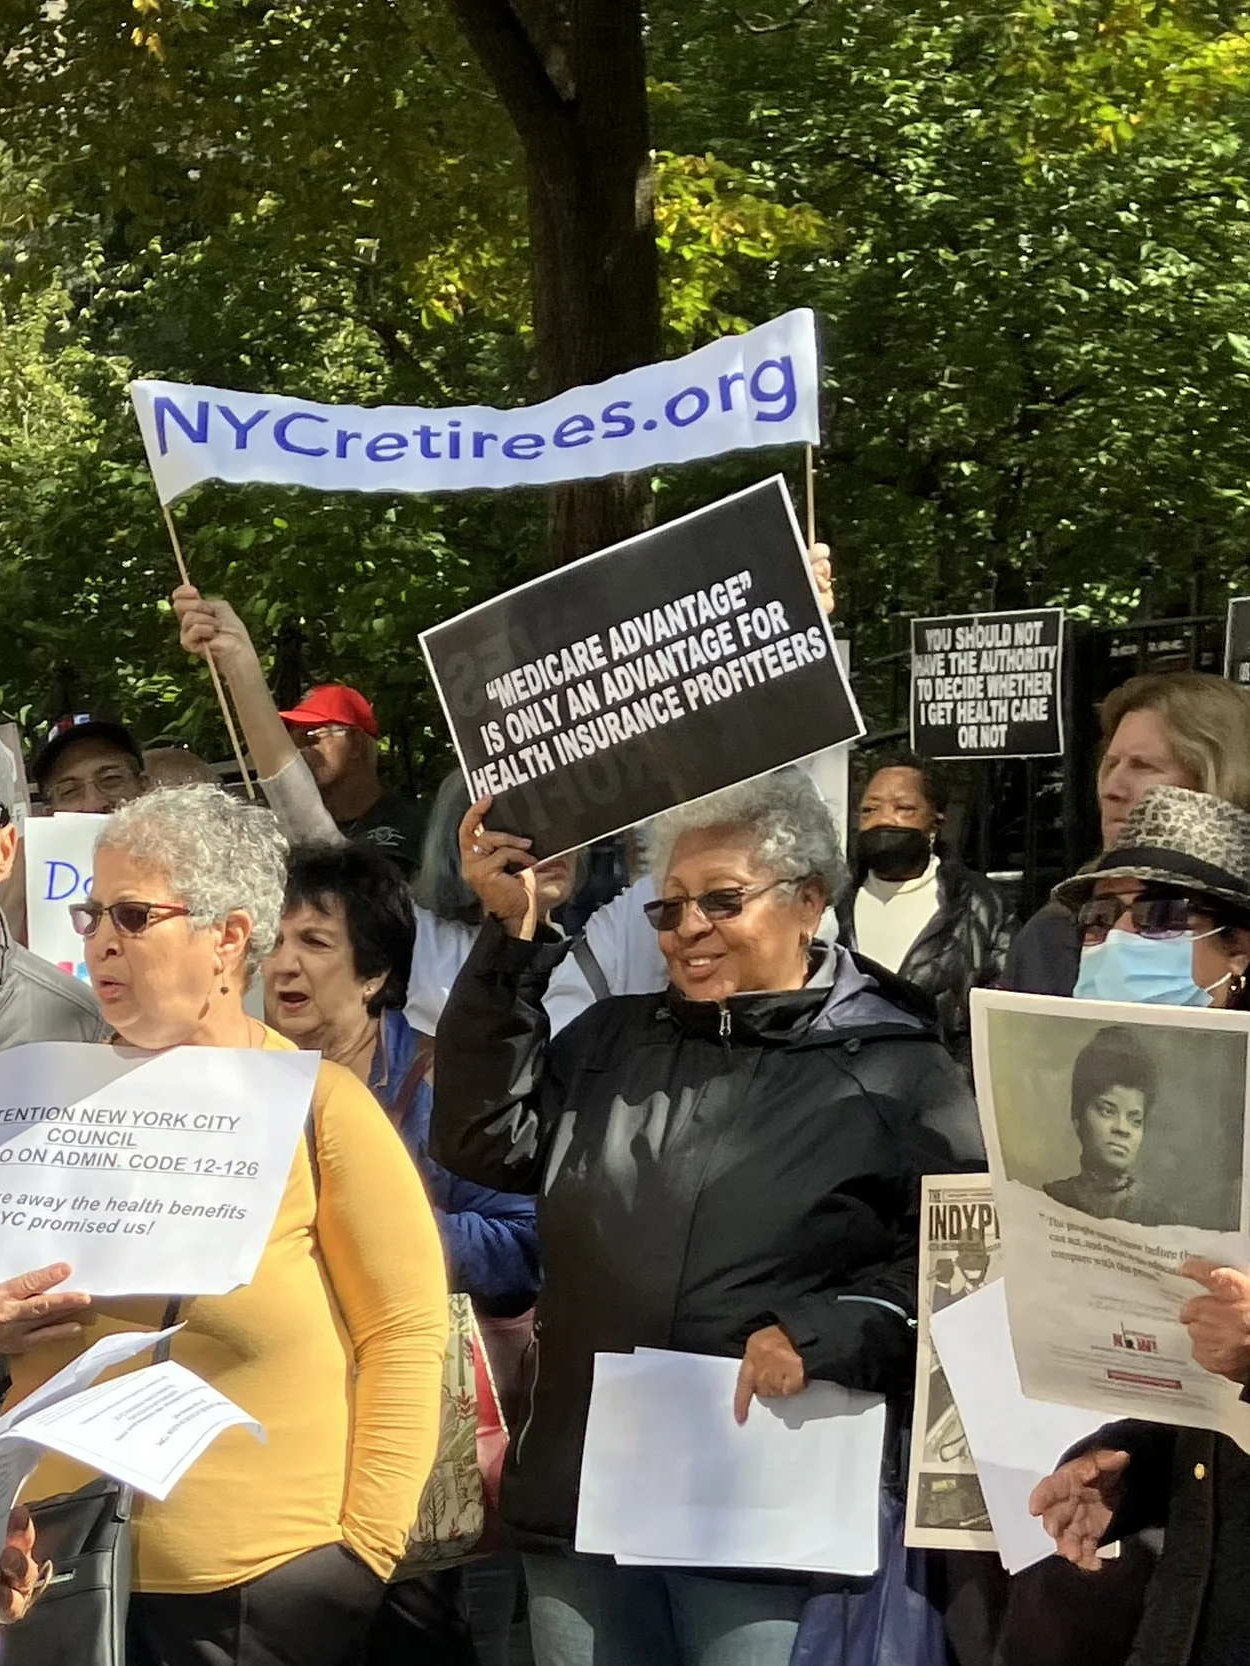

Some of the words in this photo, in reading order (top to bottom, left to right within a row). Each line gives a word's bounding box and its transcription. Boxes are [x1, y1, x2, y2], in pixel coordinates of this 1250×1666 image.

[153, 354, 798, 462] NYCretirees.org
[925, 627, 952, 651] YOU
[954, 622, 1012, 650] SHOULD
[1014, 620, 1044, 646] NOT
[914, 653, 946, 677] HAVE
[948, 651, 977, 675] THE
[979, 645, 1058, 673] AUTHORITY
[480, 720, 505, 756] IS
[506, 694, 562, 745] ONLY
[566, 679, 601, 720] AN
[602, 621, 738, 705] ADVANTAGE
[736, 600, 790, 648] FOR
[916, 678, 933, 701] TO
[934, 675, 985, 701] DECIDE
[986, 671, 1053, 698] WHETHER
[471, 741, 556, 800] HEALTH
[553, 685, 685, 766] INSURANCE
[682, 626, 827, 711] PROFITEERS
[920, 703, 926, 725] I
[927, 701, 954, 725] GET
[956, 699, 1008, 724] HEALTH
[1010, 697, 1049, 722] CARE
[958, 725, 978, 748] OR
[980, 724, 1008, 748] NOT
[80, 1109, 127, 1124] NEW
[132, 1110, 188, 1128] YORK
[193, 1114, 241, 1131] CITY
[47, 1128, 137, 1147] COUNCIL
[18, 1148, 47, 1163] ON
[51, 1151, 121, 1168] ADMIN.
[129, 1154, 188, 1171] CODE
[193, 1158, 259, 1176] 12-126
[16, 1193, 67, 1212] away
[71, 1196, 100, 1211] the
[105, 1197, 164, 1214] health
[168, 1200, 248, 1220] benefits
[27, 1216, 120, 1234] promised
[123, 1220, 156, 1235] us!
